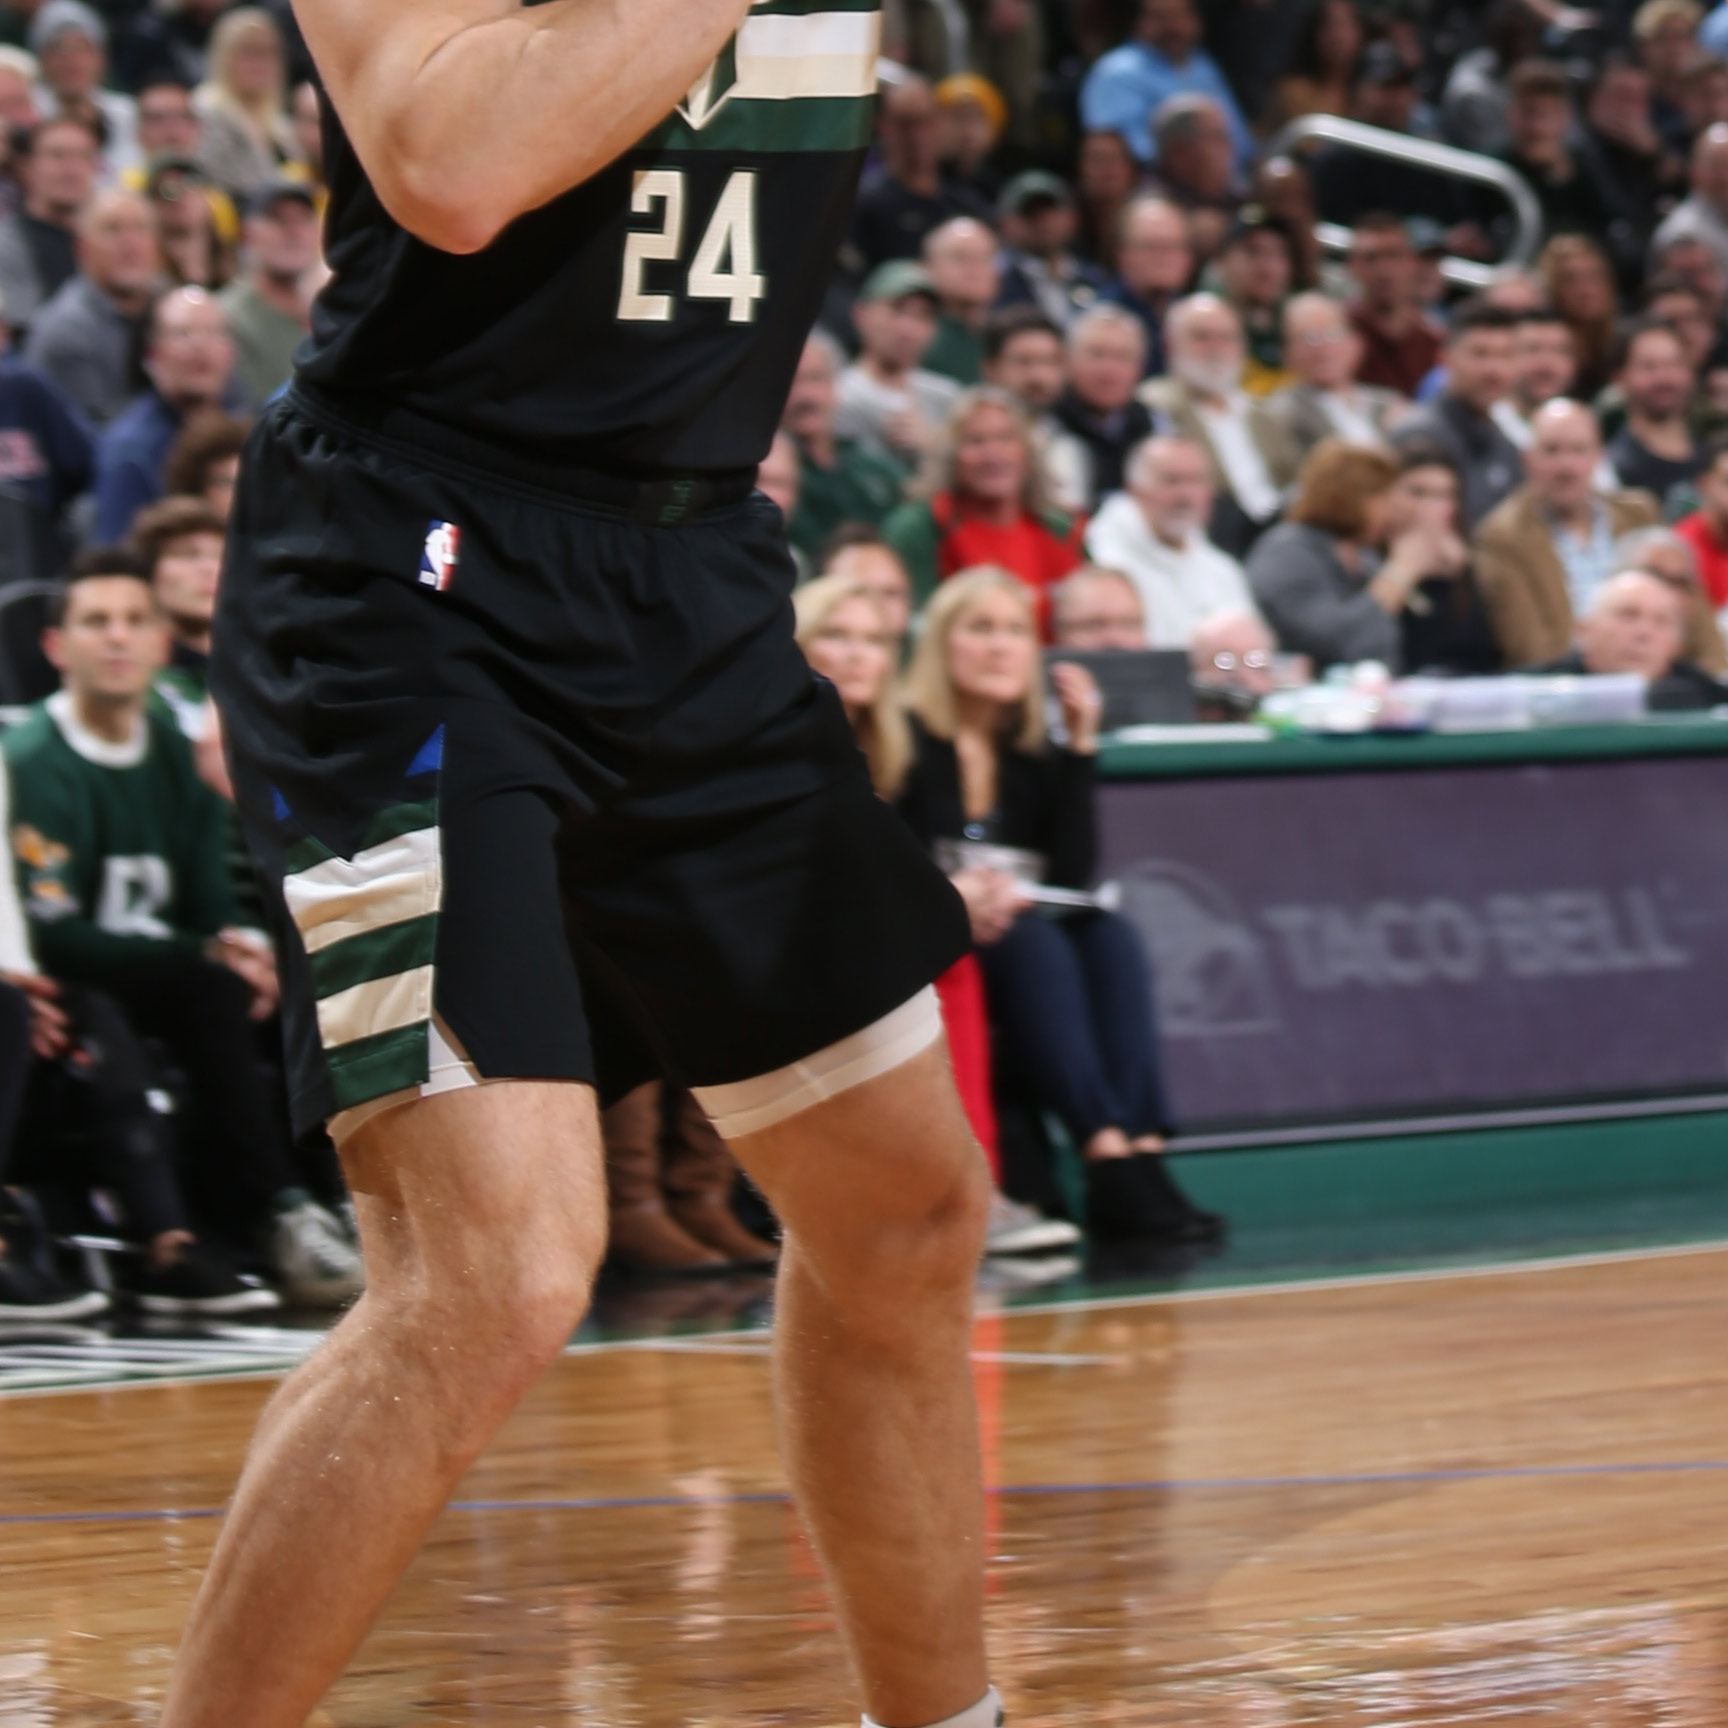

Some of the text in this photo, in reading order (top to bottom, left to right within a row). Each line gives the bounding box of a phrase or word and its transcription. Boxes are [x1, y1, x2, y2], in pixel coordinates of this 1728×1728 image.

[614, 166, 766, 326] 24
[1263, 889, 1690, 989] TACO BELL
